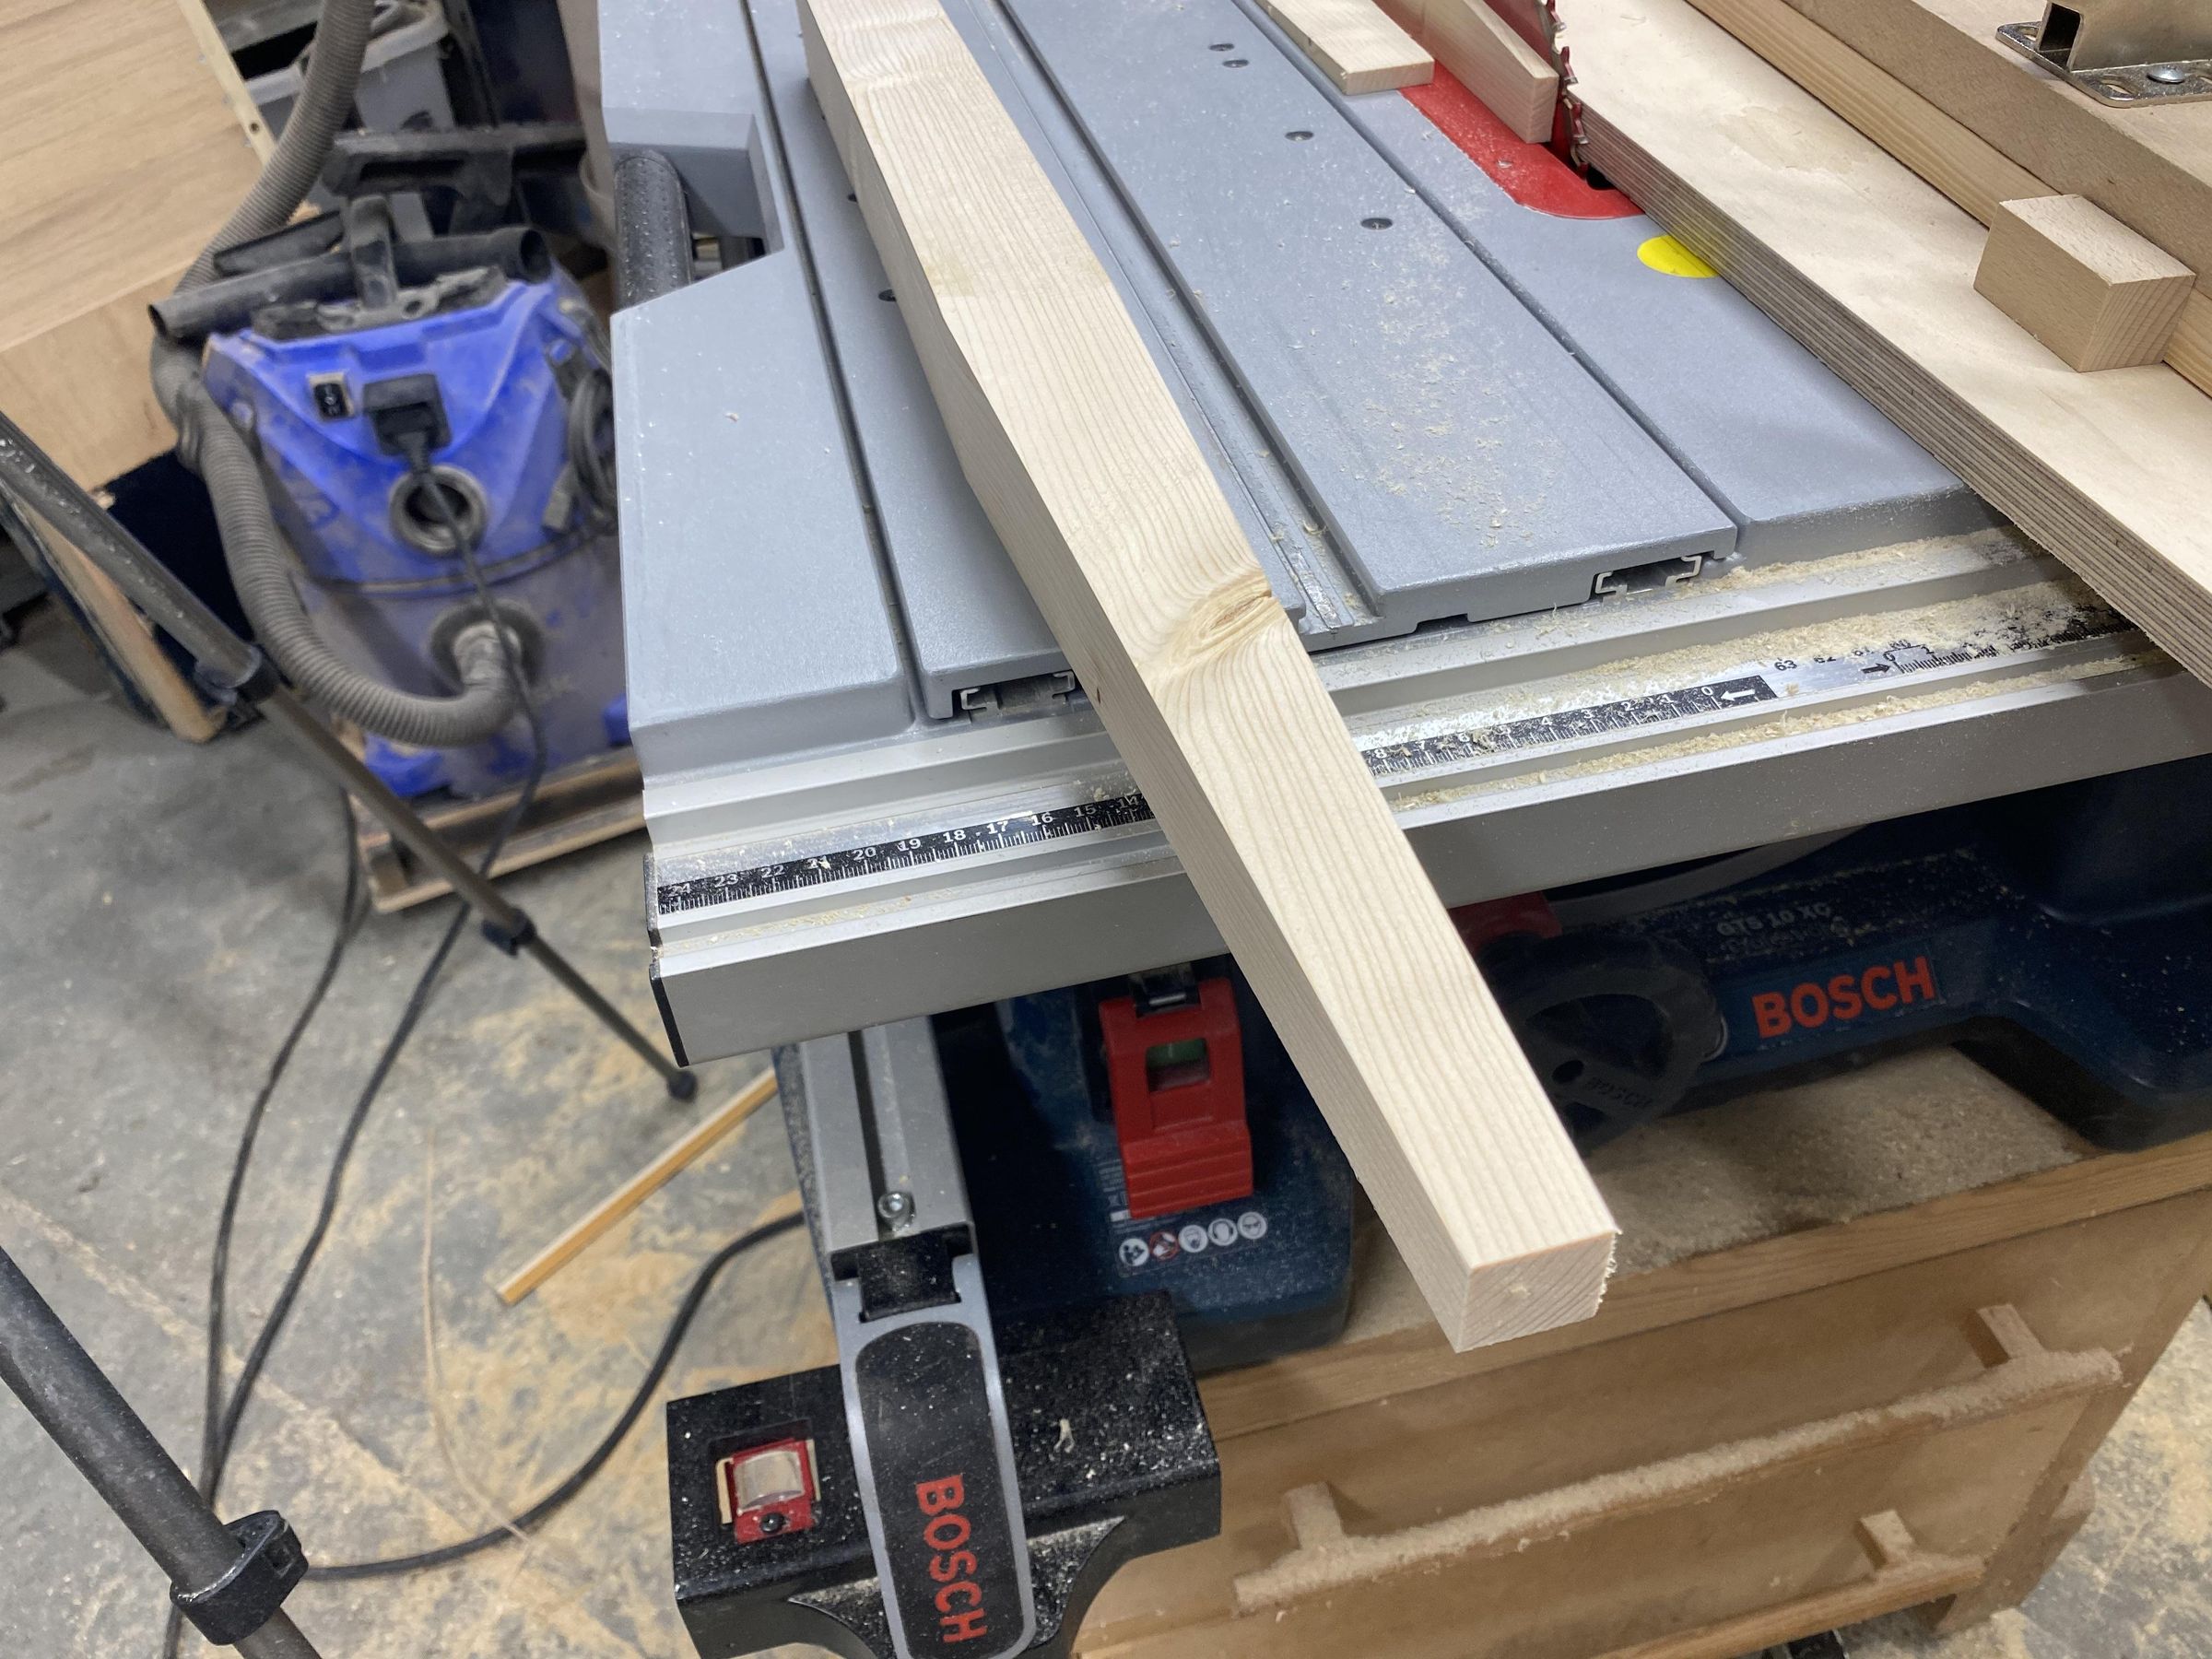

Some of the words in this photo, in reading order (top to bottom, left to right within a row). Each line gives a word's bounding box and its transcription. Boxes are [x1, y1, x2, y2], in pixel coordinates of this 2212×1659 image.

[1774, 659, 1797, 671] 63
[1374, 747, 1388, 759] 8
[1541, 716, 1553, 726] 4
[1581, 708, 1595, 719] 3
[1621, 701, 1635, 712] 2
[1700, 686, 1713, 696] 0
[713, 873, 738, 888] 23
[760, 865, 784, 878] 22
[853, 846, 877, 861] 20
[897, 838, 922, 852] 19
[943, 830, 967, 843] 18
[986, 820, 1009, 835] 17
[1030, 812, 1053, 827] 16
[1073, 805, 1097, 818] 15
[1117, 795, 1139, 809] 14
[1752, 957, 1936, 1039] BOSCH
[915, 1474, 988, 1643] BOSCH
